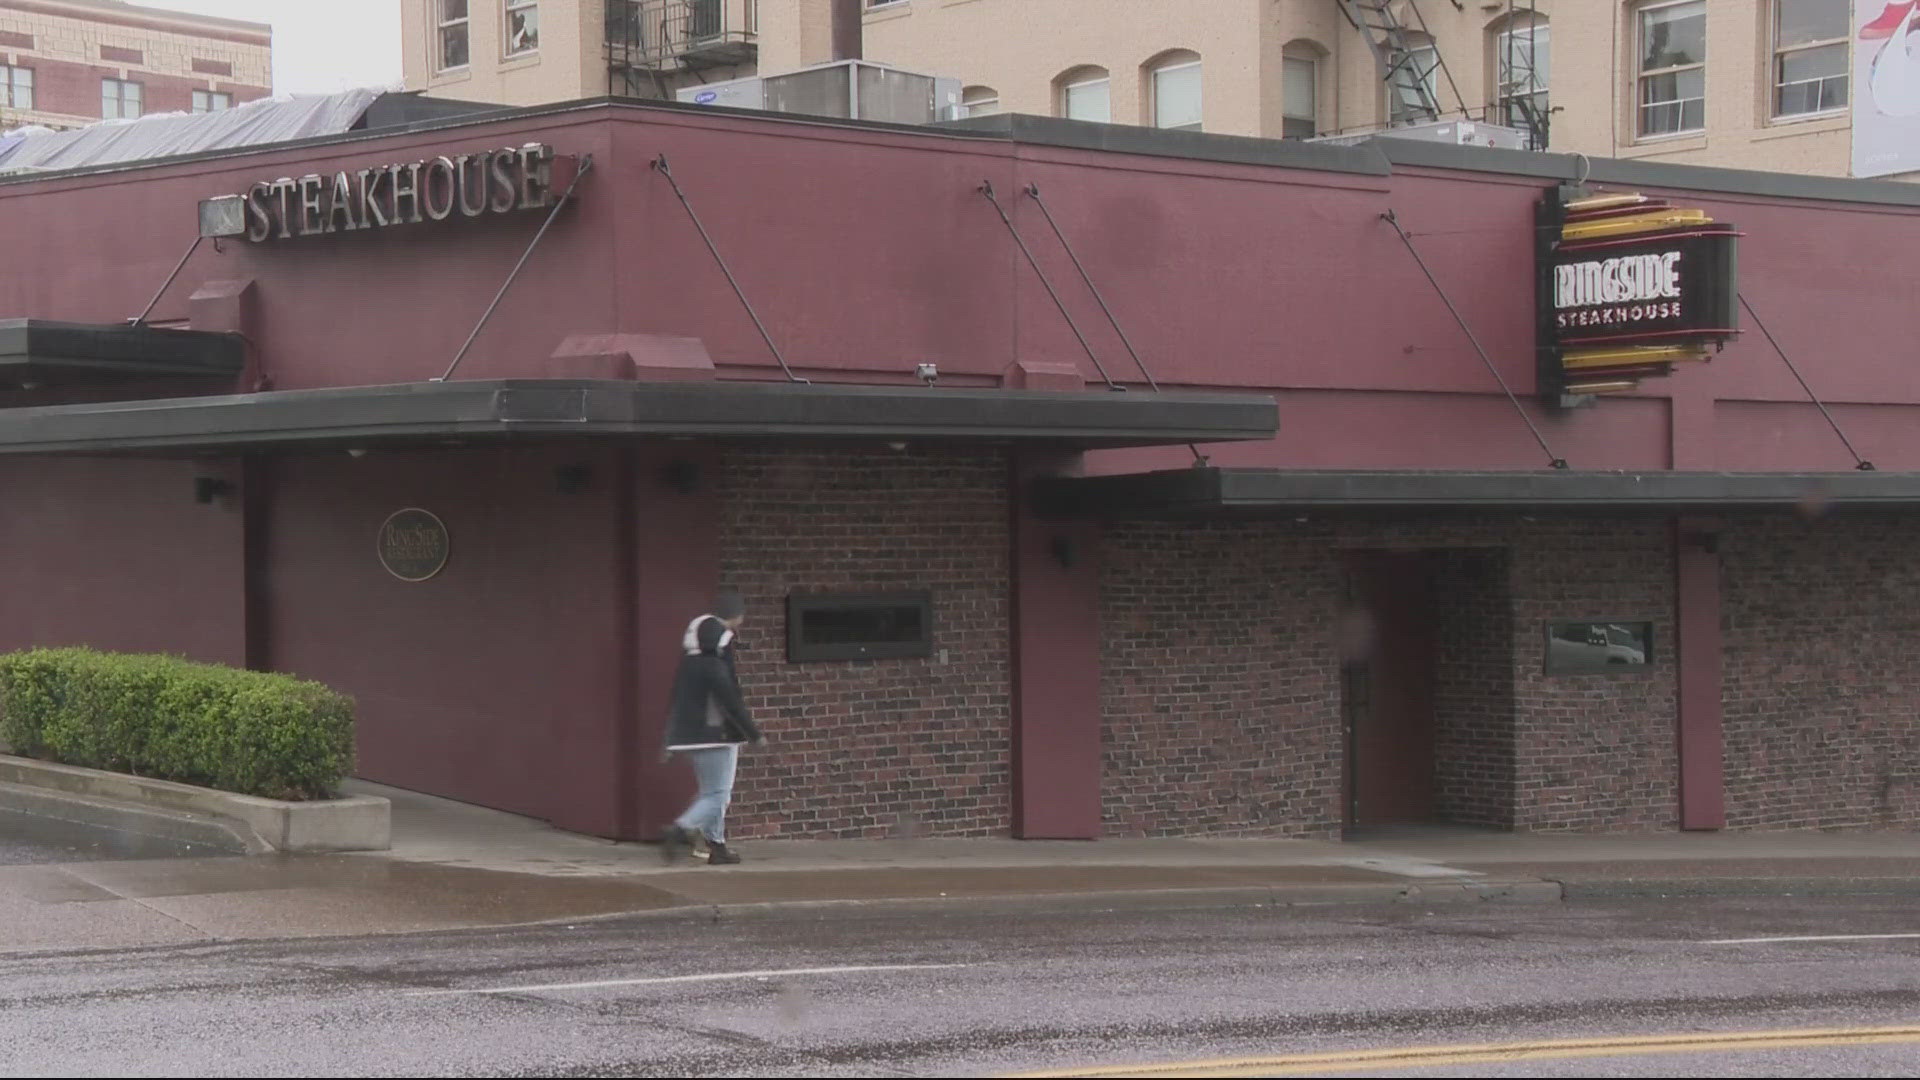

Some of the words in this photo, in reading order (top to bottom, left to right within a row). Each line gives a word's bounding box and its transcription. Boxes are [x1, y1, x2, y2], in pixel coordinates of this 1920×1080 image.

[248, 142, 551, 242] STEAKHOUSE
[1554, 251, 1681, 309] RINGSIDE
[1558, 302, 1681, 327] STEAKHOUSE
